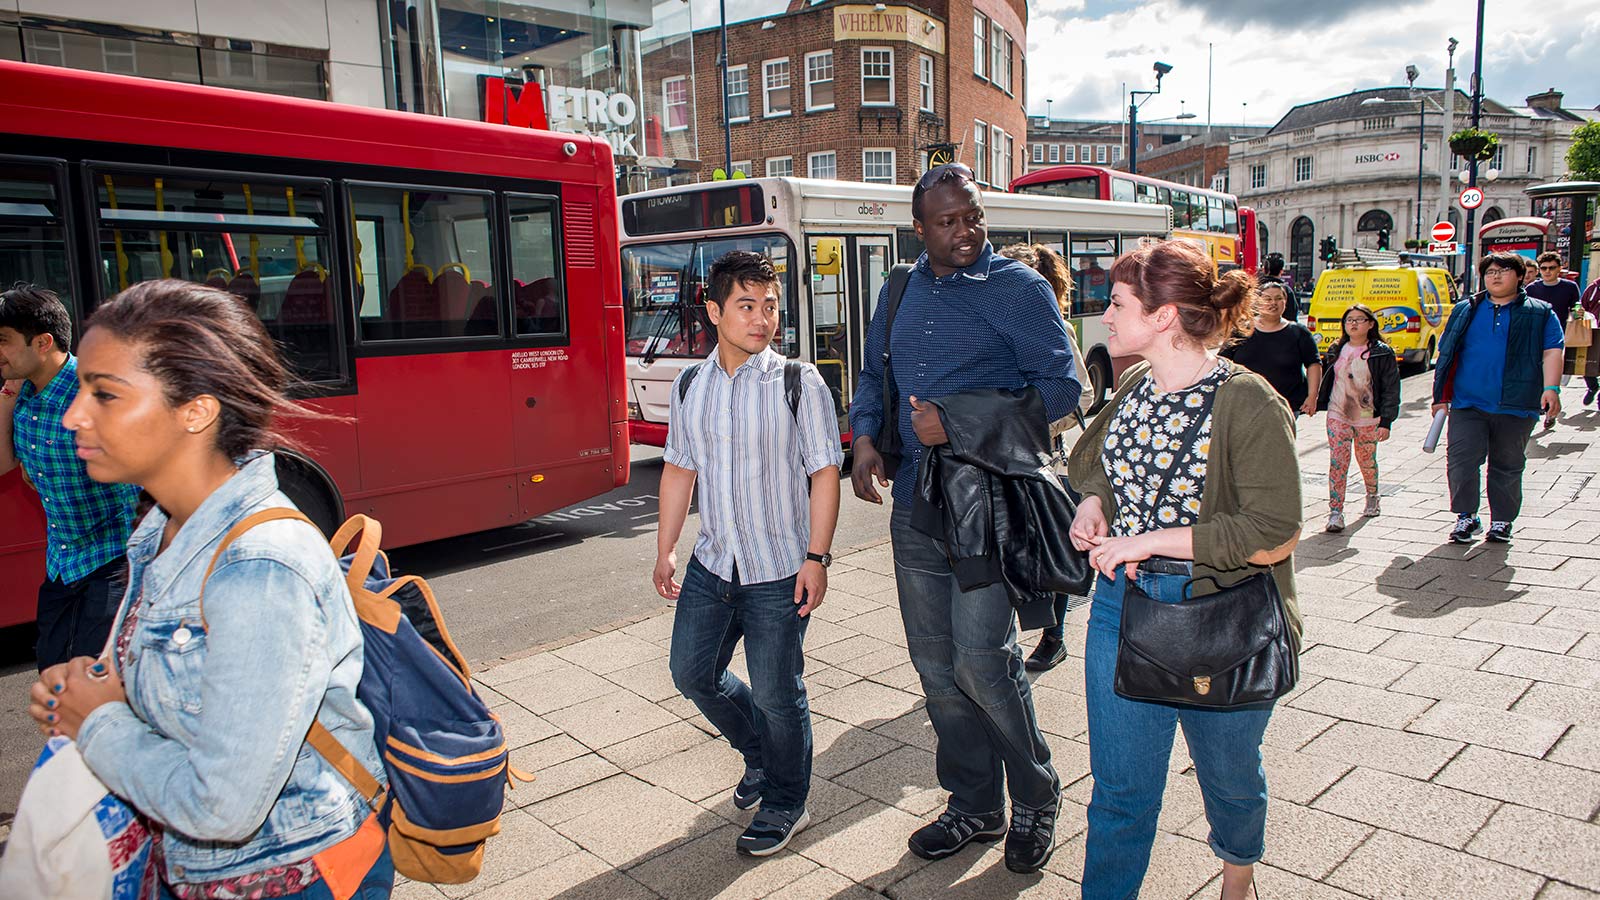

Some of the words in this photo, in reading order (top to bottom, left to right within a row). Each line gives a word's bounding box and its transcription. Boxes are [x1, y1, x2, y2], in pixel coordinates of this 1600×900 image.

[485, 76, 637, 131] METRO
[1355, 153, 1384, 164] HSBC
[1256, 198, 1290, 209] HSBC
[1463, 193, 1480, 204] 20
[858, 202, 884, 216] abellio
[1498, 227, 1528, 235] Telephone
